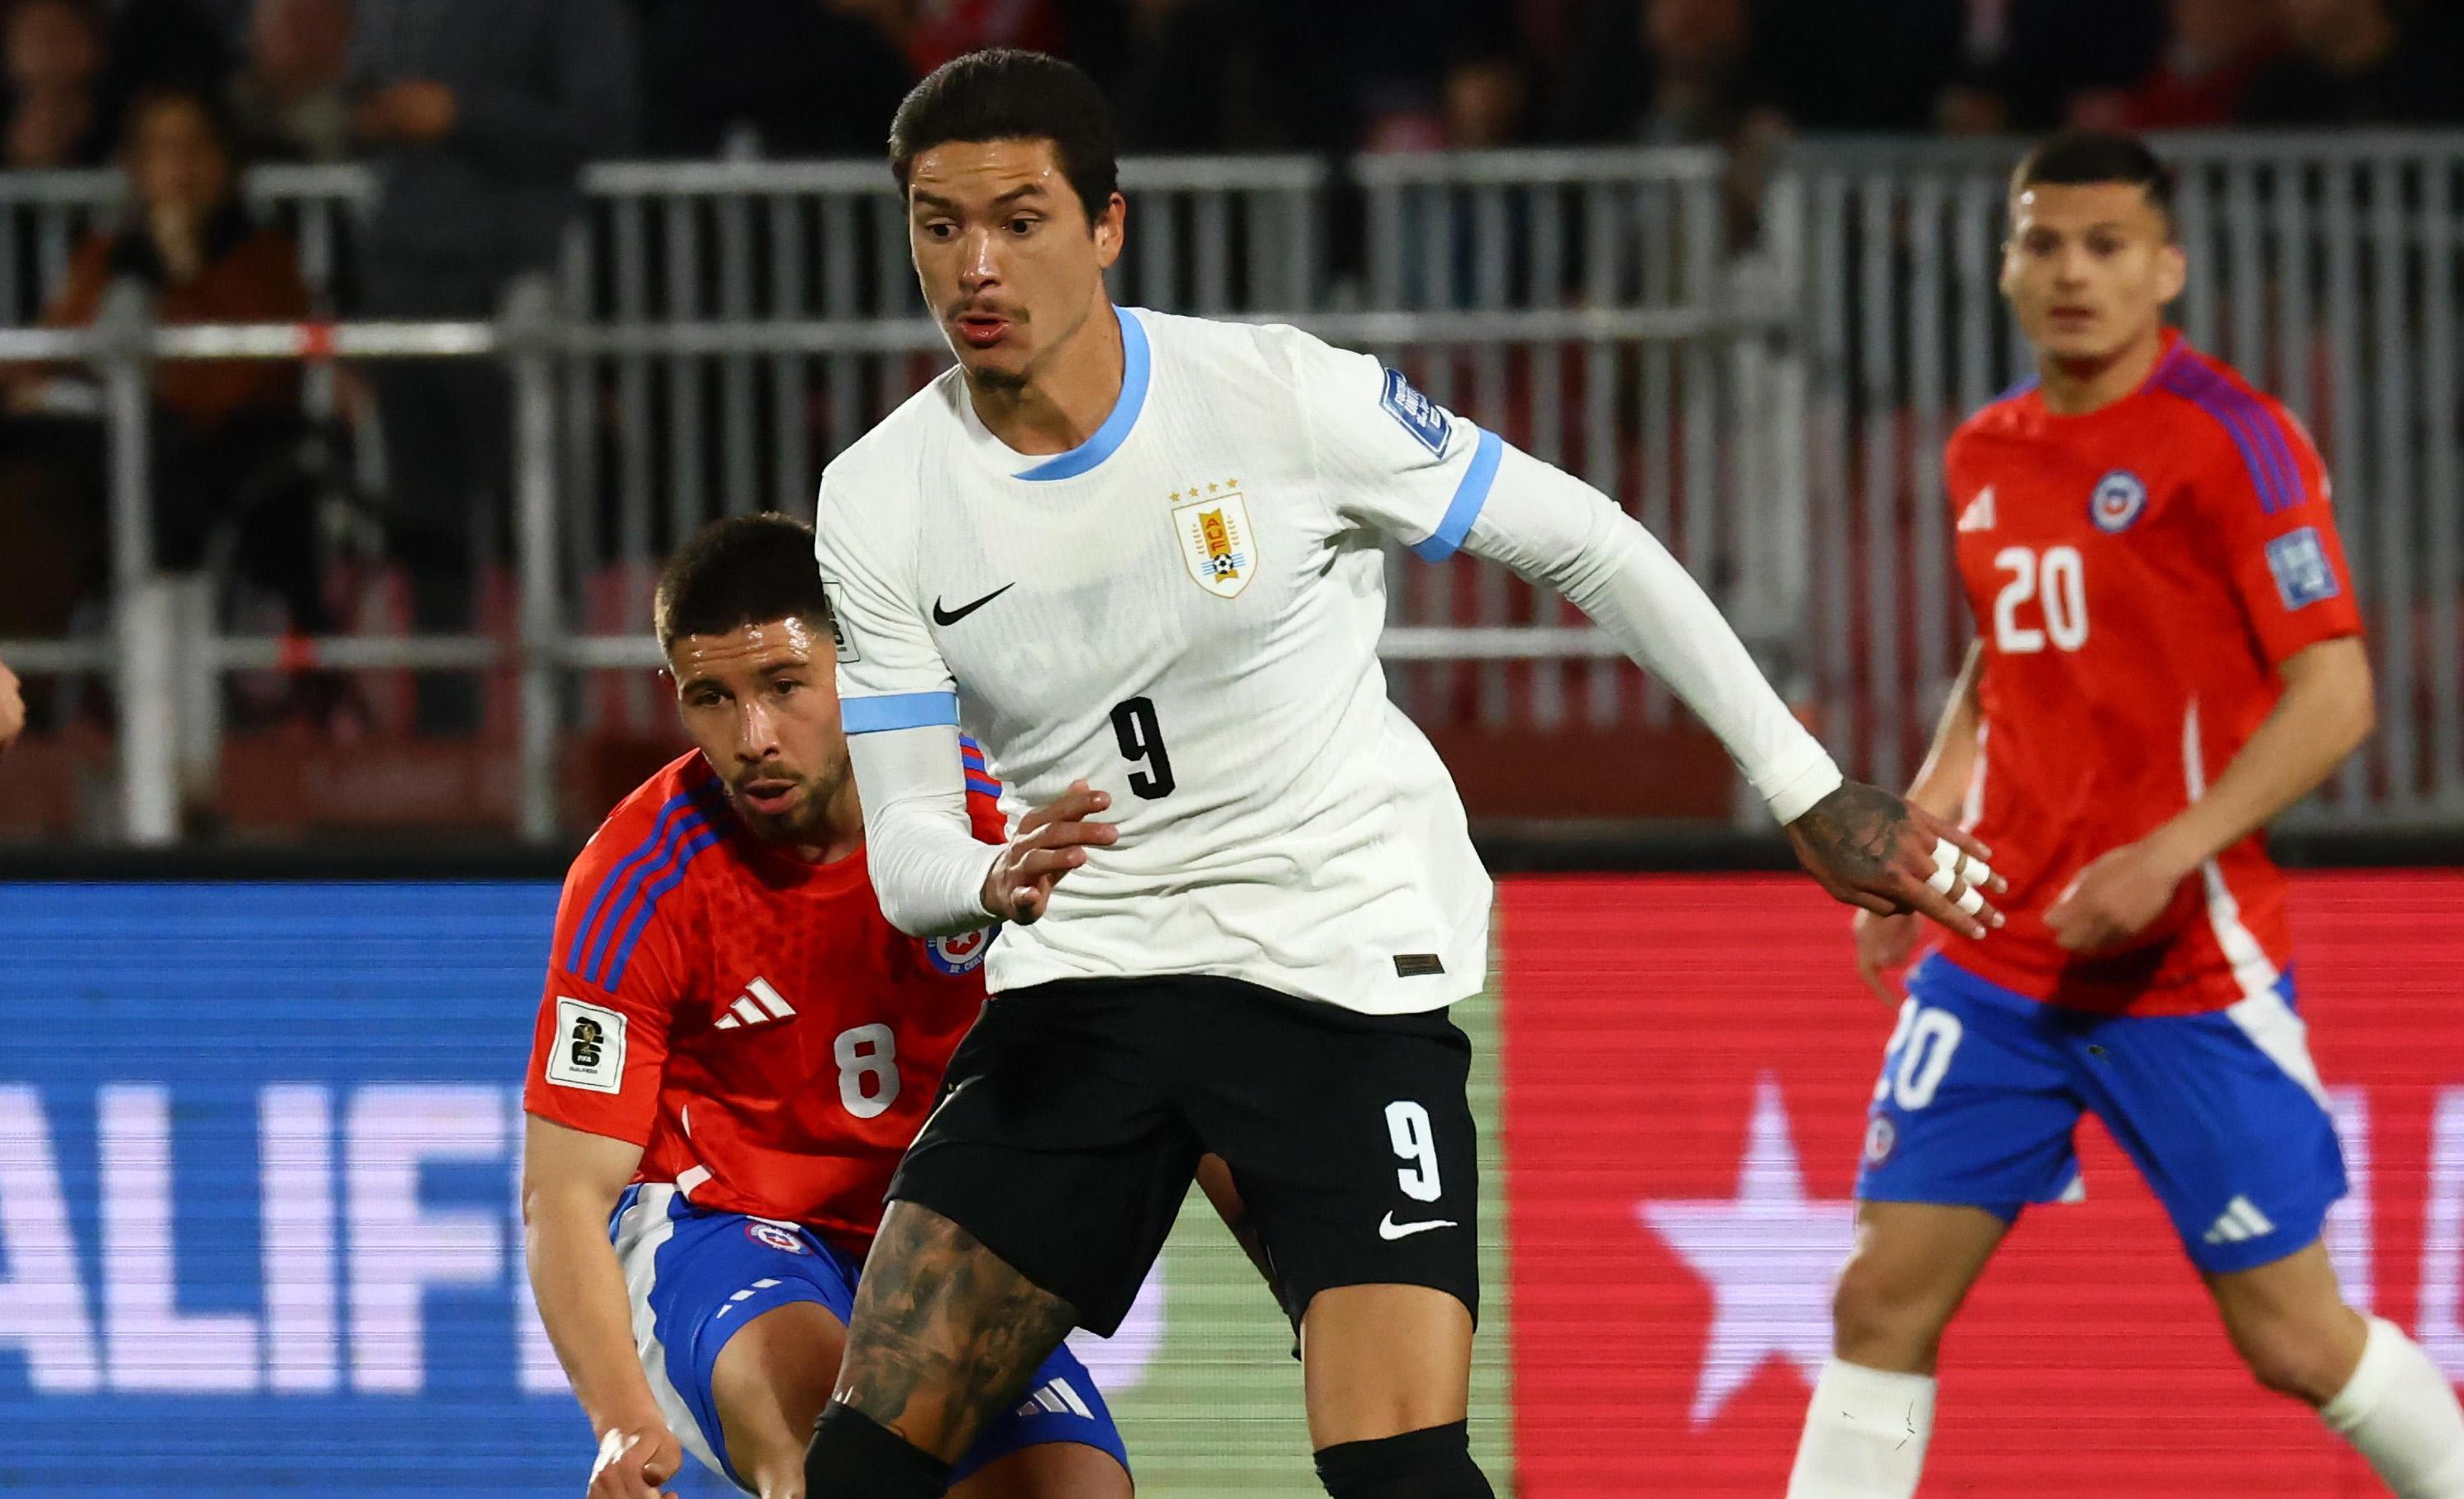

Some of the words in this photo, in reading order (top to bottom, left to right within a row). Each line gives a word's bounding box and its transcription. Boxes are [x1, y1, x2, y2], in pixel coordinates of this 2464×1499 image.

[1994, 546, 2089, 654] 20
[1110, 696, 1176, 800] 9
[833, 1023, 900, 1119] 8
[1384, 1101, 1442, 1202] 9
